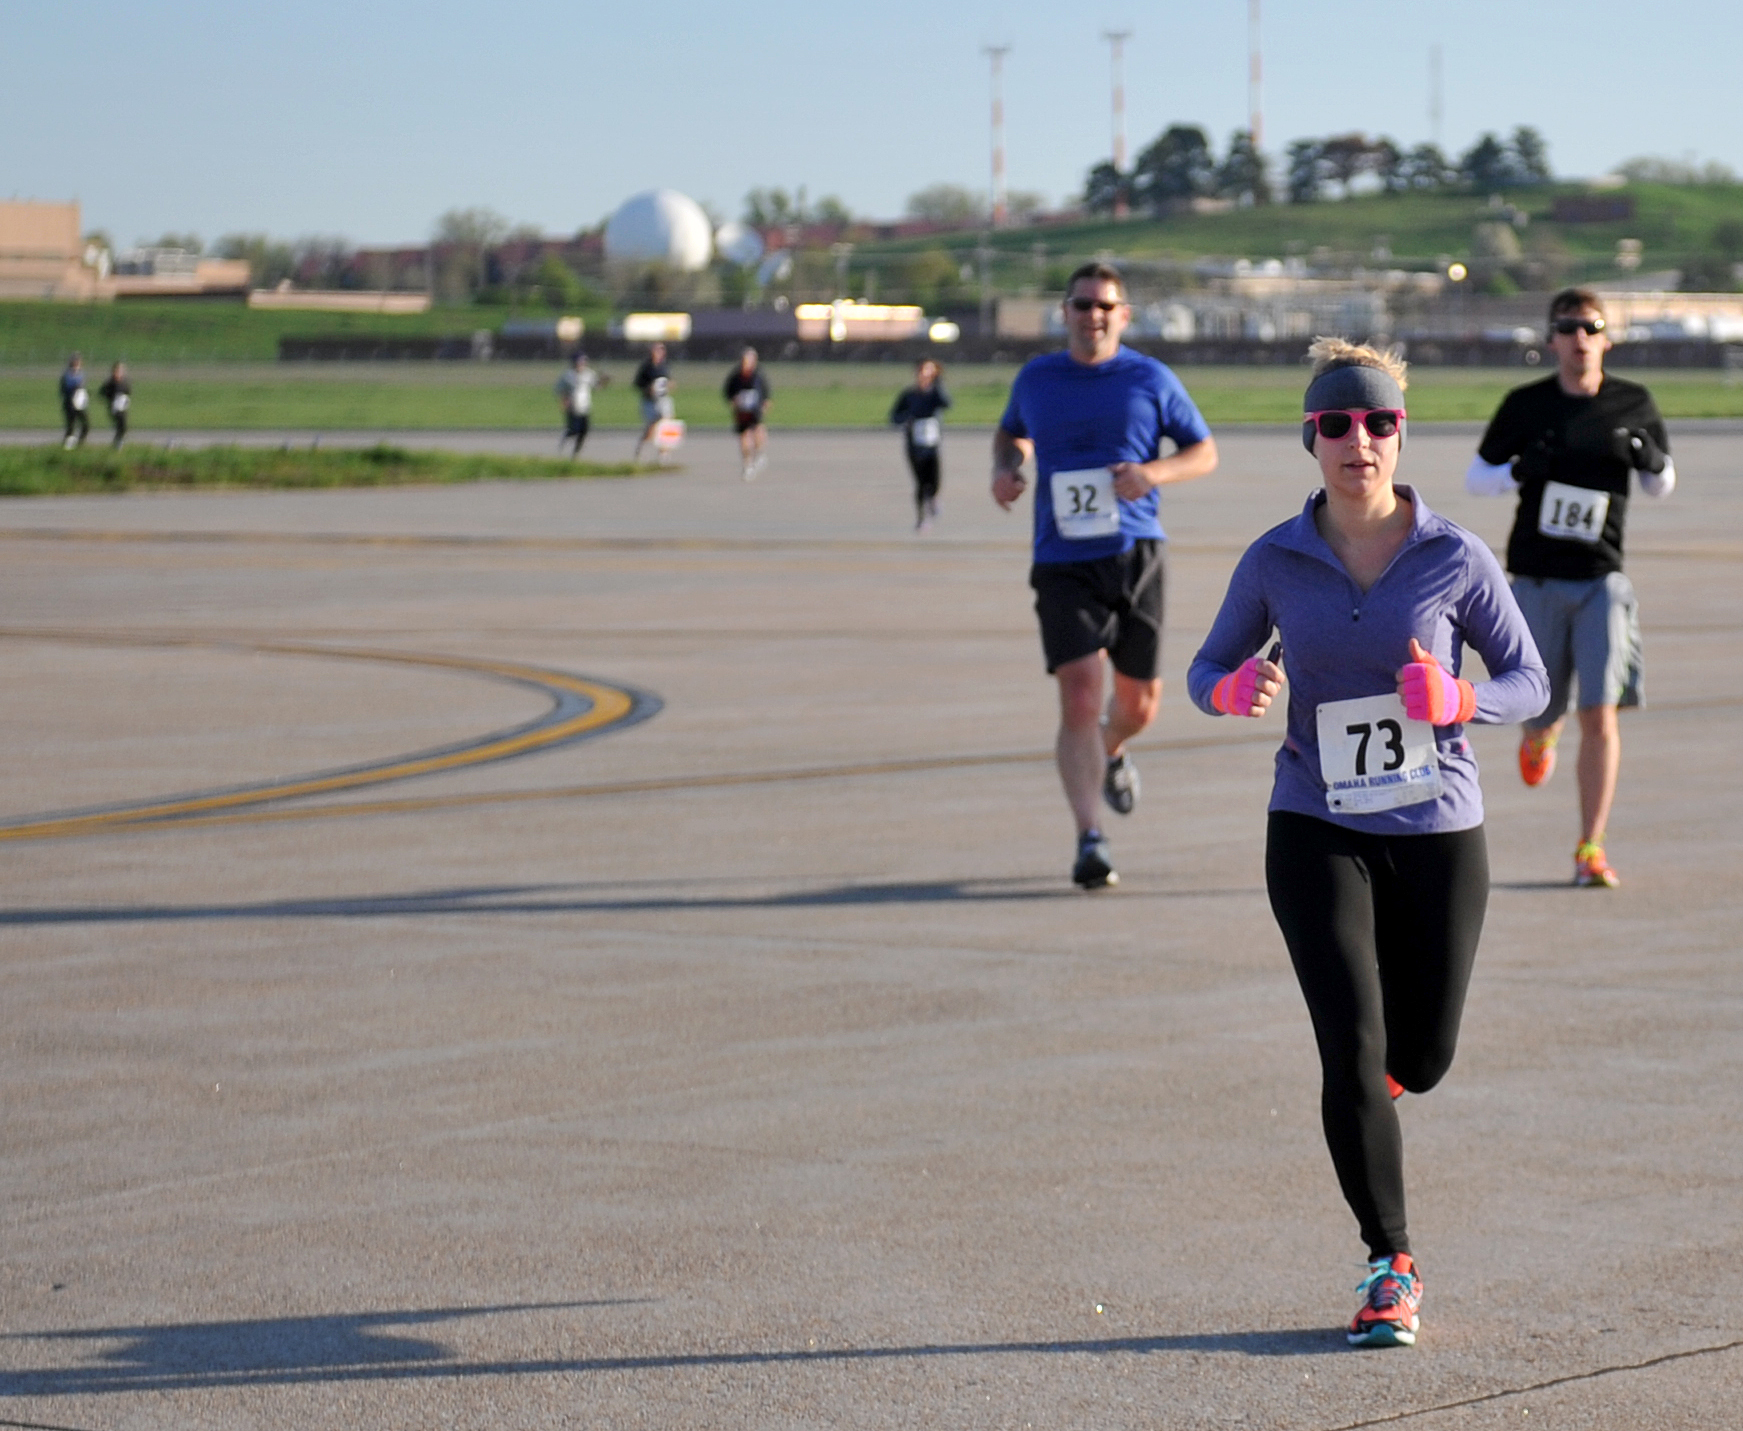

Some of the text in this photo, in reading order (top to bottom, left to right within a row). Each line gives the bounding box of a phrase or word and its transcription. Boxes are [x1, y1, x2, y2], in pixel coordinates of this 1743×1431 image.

[1066, 484, 1099, 514] 32
[1550, 499, 1595, 530] 184
[1346, 718, 1405, 776] 73
[1333, 778, 1367, 790] OMAHA
[1368, 771, 1408, 787] RUNNING
